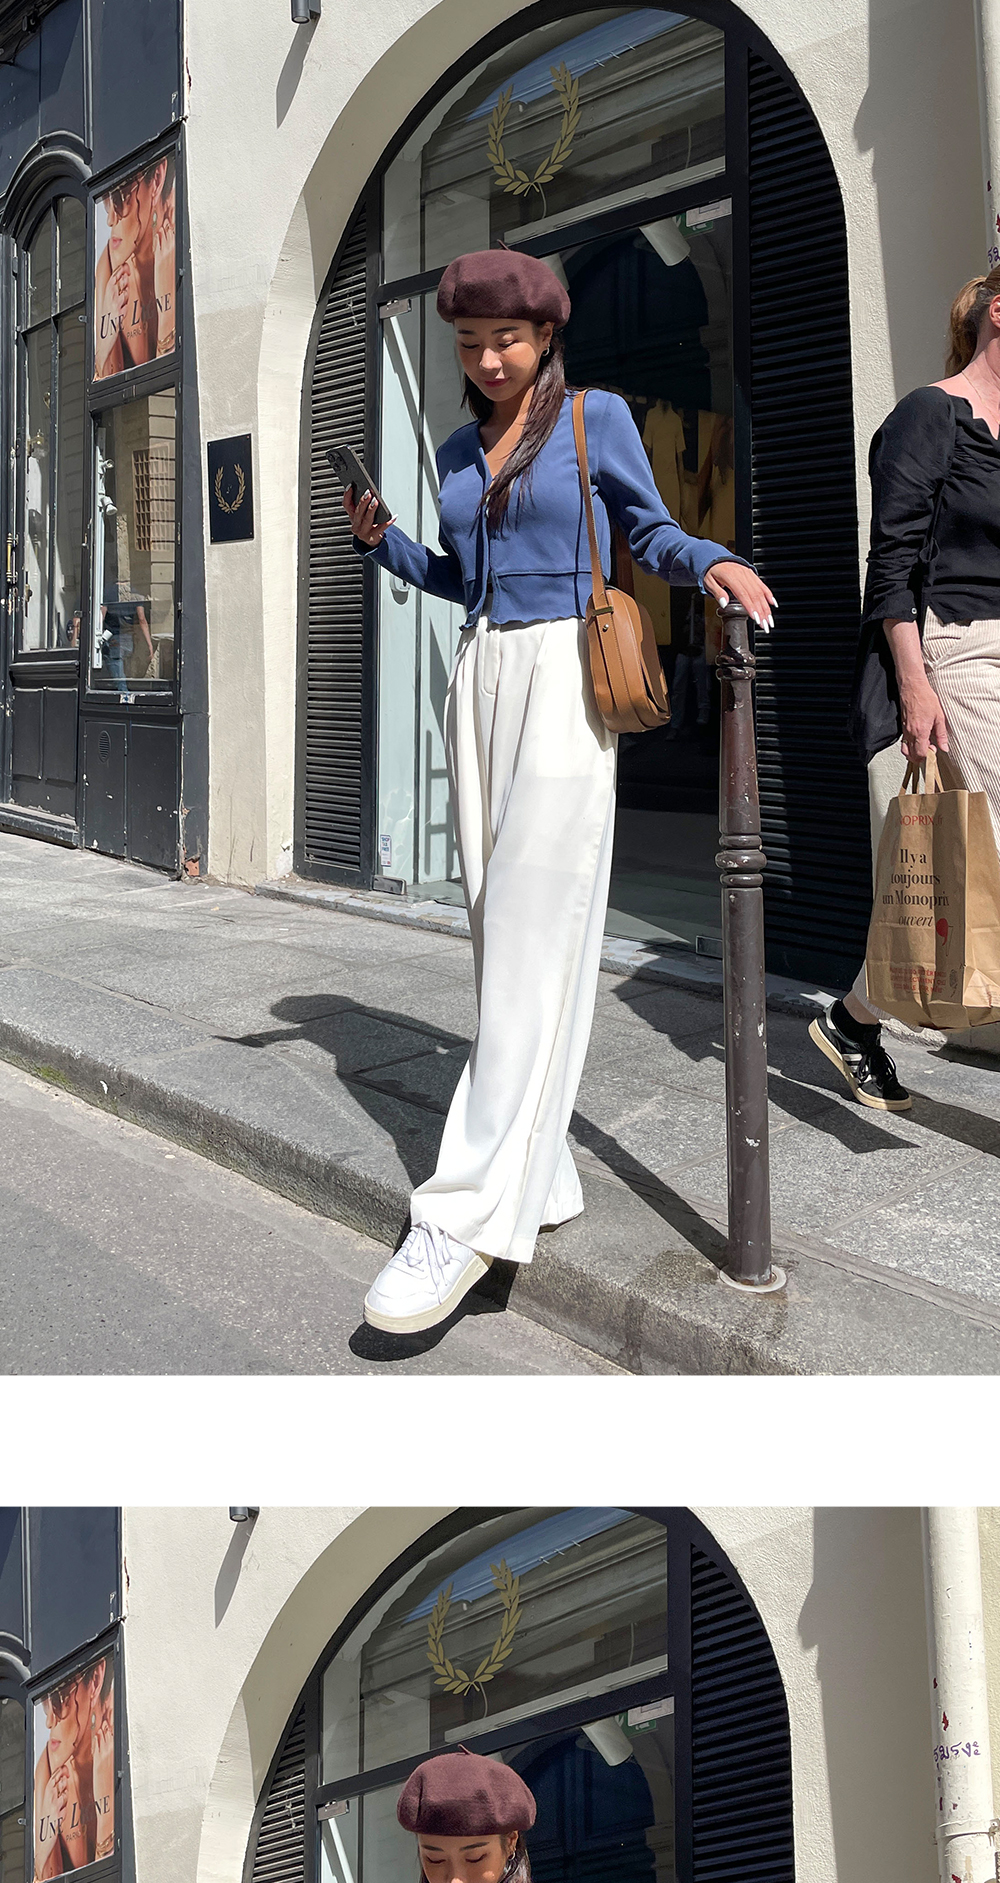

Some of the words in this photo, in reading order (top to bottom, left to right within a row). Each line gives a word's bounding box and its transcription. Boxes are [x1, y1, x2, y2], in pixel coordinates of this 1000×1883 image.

[900, 848, 909, 864] Il
[919, 853, 927, 864] a
[891, 868, 941, 889] toujours
[898, 914, 934, 927] ouvert
[70, 1795, 111, 1829] LNE
